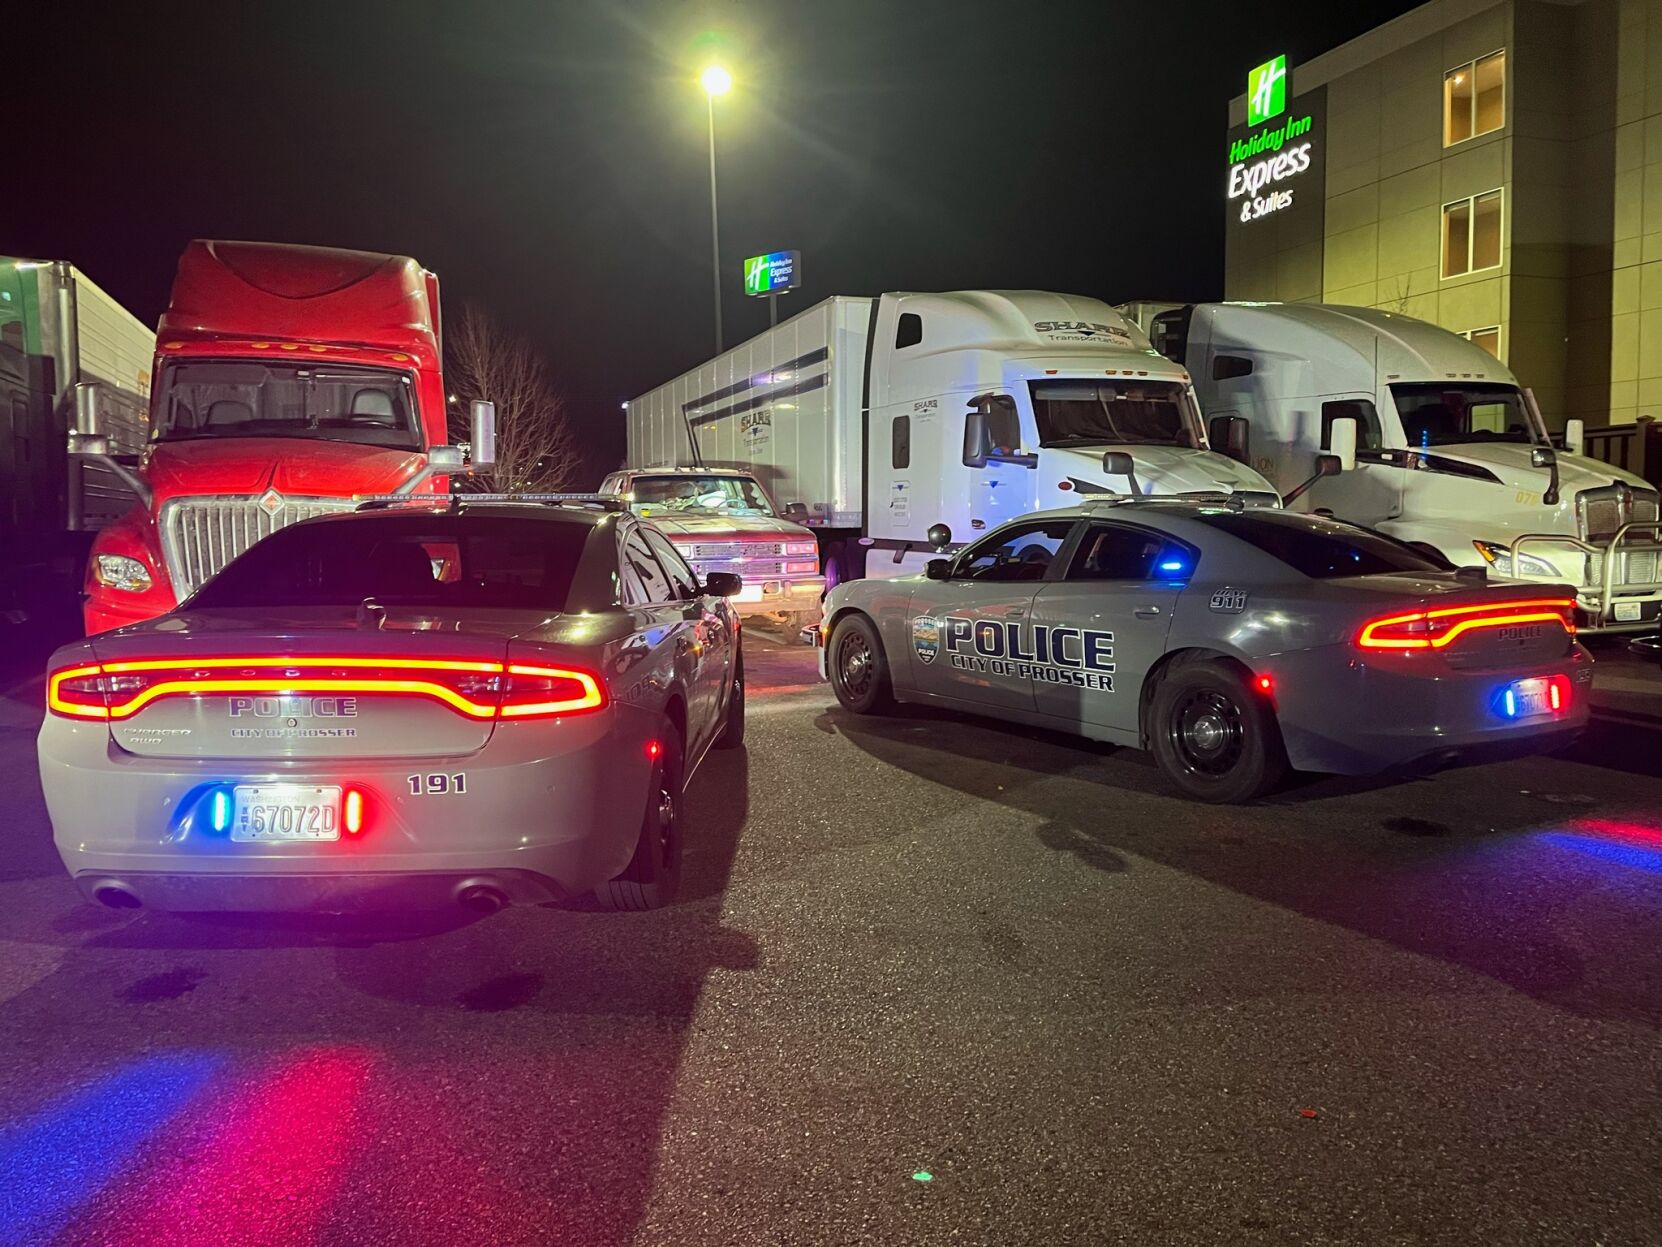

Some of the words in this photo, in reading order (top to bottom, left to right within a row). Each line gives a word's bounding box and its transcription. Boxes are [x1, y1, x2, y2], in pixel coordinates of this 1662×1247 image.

[1229, 126, 1285, 165] Holiday
[1285, 115, 1312, 141] Inn
[1228, 142, 1312, 199] Express
[1240, 200, 1252, 223] &
[1252, 189, 1294, 219] Suites
[1049, 335, 1129, 347] Transportation
[1210, 595, 1245, 609] 911
[946, 616, 1116, 673] POLICE
[1498, 624, 1544, 641] POLICE
[951, 653, 988, 673] CITY
[991, 659, 1016, 677] OF
[1019, 663, 1115, 692] PROSSER
[228, 696, 358, 717] POLICE
[231, 727, 263, 738] CITY
[266, 728, 287, 738] OF
[287, 727, 358, 738] PROSSER
[407, 772, 467, 795] 191
[251, 804, 336, 834] 67072D
